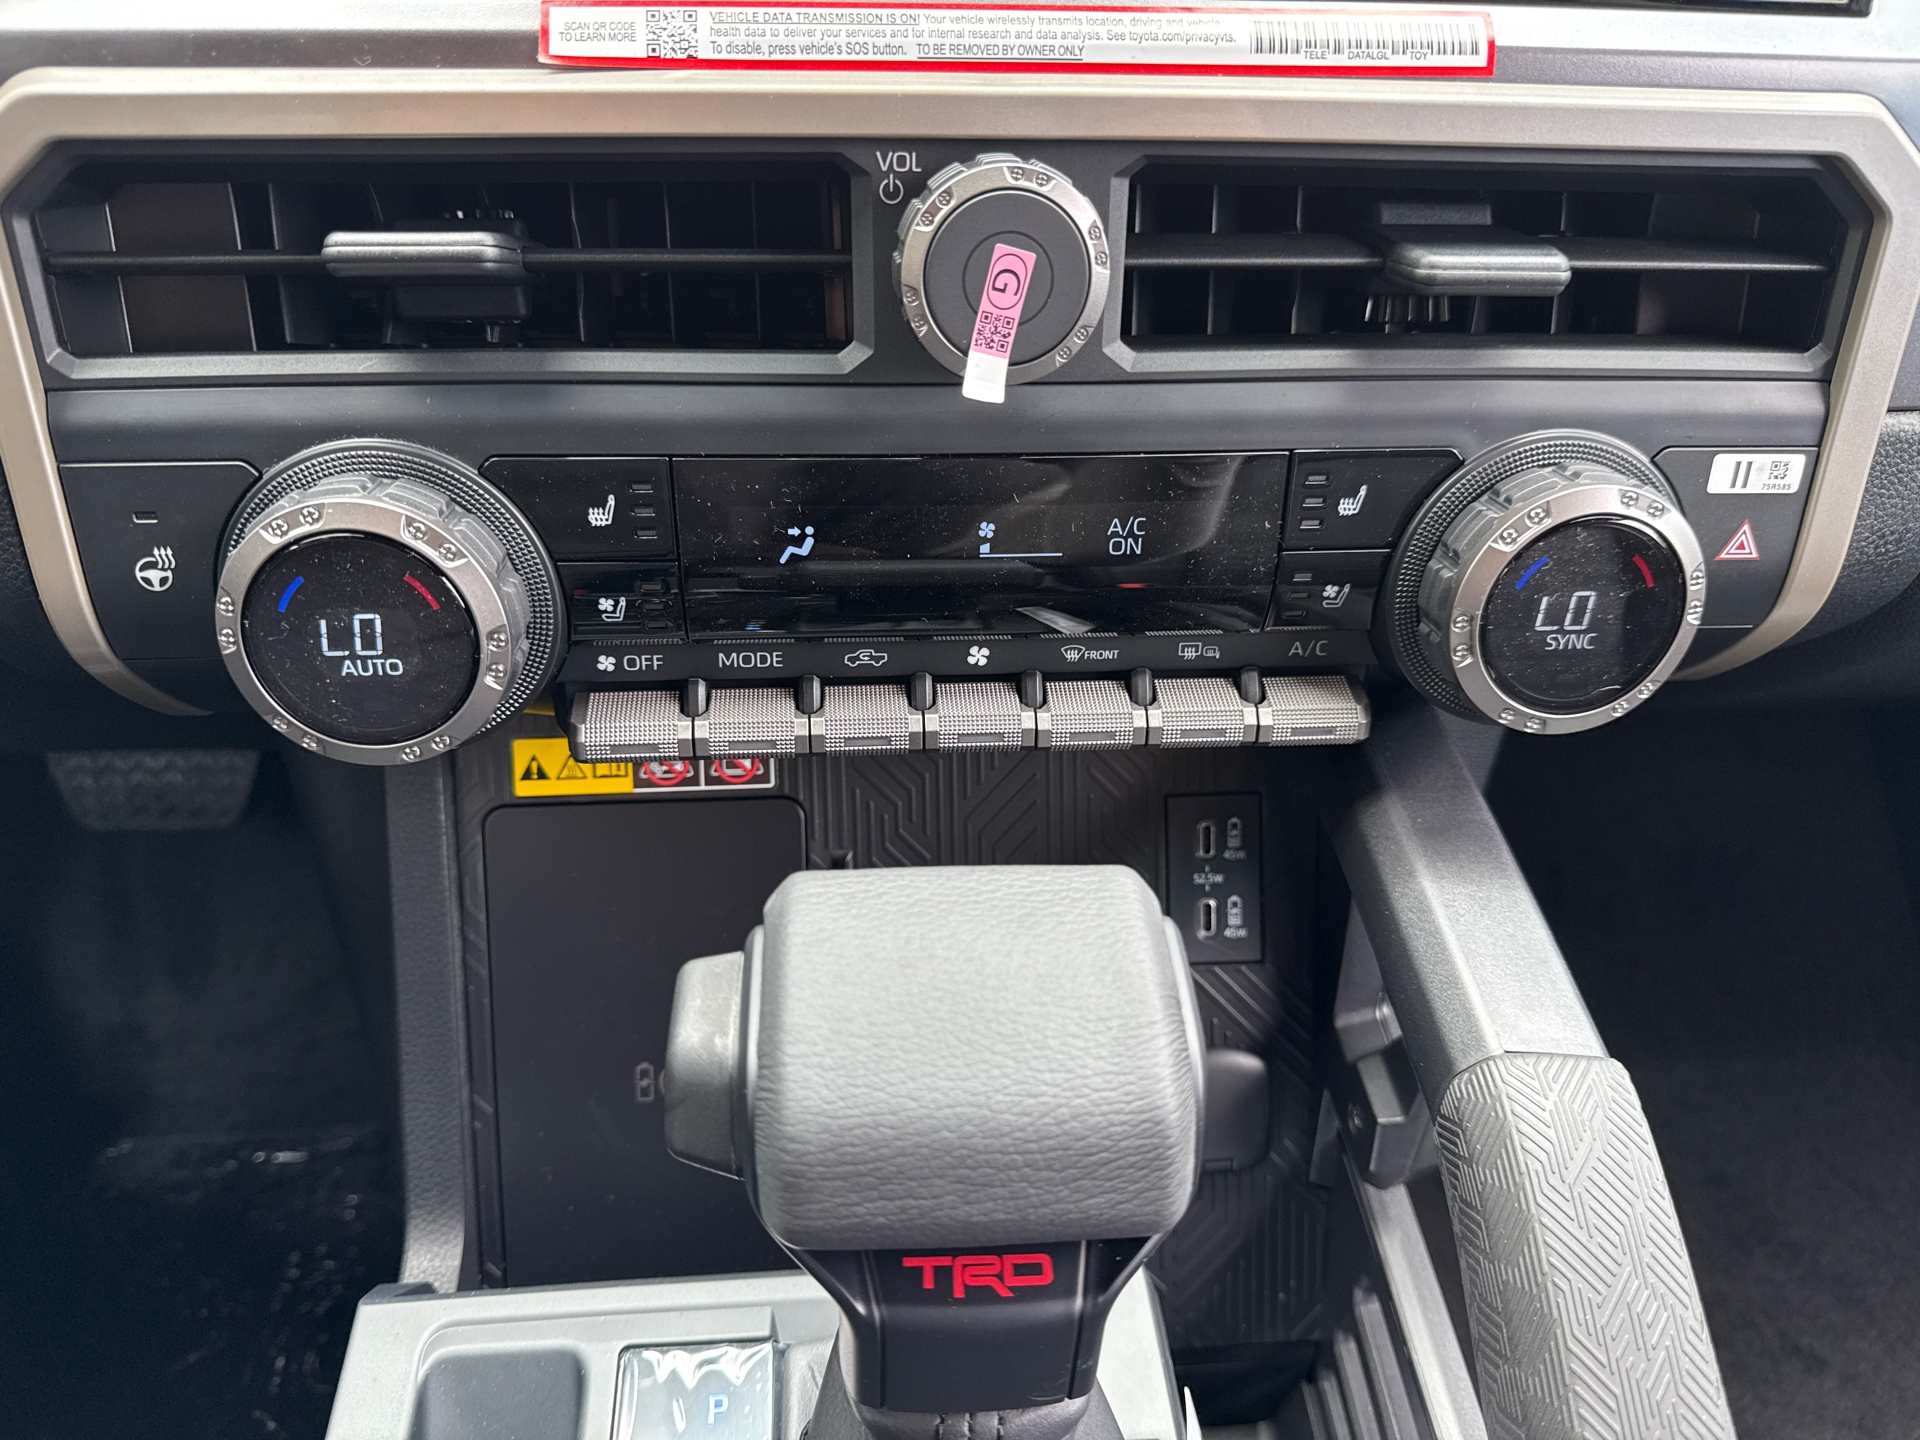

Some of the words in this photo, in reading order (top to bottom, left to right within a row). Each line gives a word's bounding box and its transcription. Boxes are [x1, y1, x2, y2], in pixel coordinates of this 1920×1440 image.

[564, 22, 591, 31] SCAN
[592, 22, 607, 32] QR
[609, 22, 637, 31] CODE
[709, 12, 760, 23] VEHICLE
[763, 12, 793, 23] DATA
[795, 12, 883, 24] TRANSMISSION
[886, 13, 897, 24] IS
[900, 13, 920, 24] ON!
[923, 14, 946, 25] Your
[949, 14, 984, 25] vehicle
[987, 14, 1036, 28] wirelessly
[1038, 15, 1083, 27] transmits
[1086, 16, 1127, 29] location,
[1130, 16, 1163, 30] driving
[1166, 18, 1184, 27] and
[559, 32, 573, 42] TO
[574, 32, 607, 42] LEARN
[608, 32, 637, 42] MORE
[710, 26, 742, 38] health
[744, 26, 767, 38] data
[770, 27, 780, 38] to
[783, 26, 817, 38] deliver
[820, 28, 843, 41] your
[845, 28, 887, 39] services
[890, 28, 909, 39] and
[912, 28, 926, 39] for
[928, 28, 965, 39] internal
[968, 28, 1012, 40] research
[1014, 29, 1033, 40] and
[1036, 29, 1058, 40] data
[1060, 30, 1104, 43] analysis.
[1106, 30, 1126, 41] See
[1128, 30, 1237, 46] toyota.com/privacyvts.
[710, 41, 723, 54] To
[726, 41, 765, 56] disable,
[768, 44, 796, 57] press
[798, 42, 843, 56] vehicle's
[845, 42, 870, 56] SOS
[872, 43, 908, 56] button.
[916, 44, 931, 56] TO
[932, 44, 947, 56] BE
[949, 44, 1002, 56] REMOVED
[1002, 44, 1016, 56] BY
[1017, 44, 1056, 56] OWNER
[1058, 45, 1085, 57] ONLY
[1303, 50, 1328, 60] TELE
[1347, 51, 1390, 60] DATALGL
[1409, 51, 1428, 60] TOY
[876, 152, 922, 173] VOL
[992, 268, 1022, 297] G
[1107, 516, 1147, 536] A/C
[1108, 538, 1142, 556] ON
[1288, 640, 1330, 657] A/C
[1544, 633, 1598, 650] SYNC
[623, 654, 664, 672] OFF
[718, 652, 784, 668] MODE
[1084, 650, 1120, 660] FRONT
[341, 658, 404, 676] AUTO
[1223, 926, 1248, 938] 45W
[902, 1253, 1054, 1298] TRD
[707, 1393, 729, 1426] P
